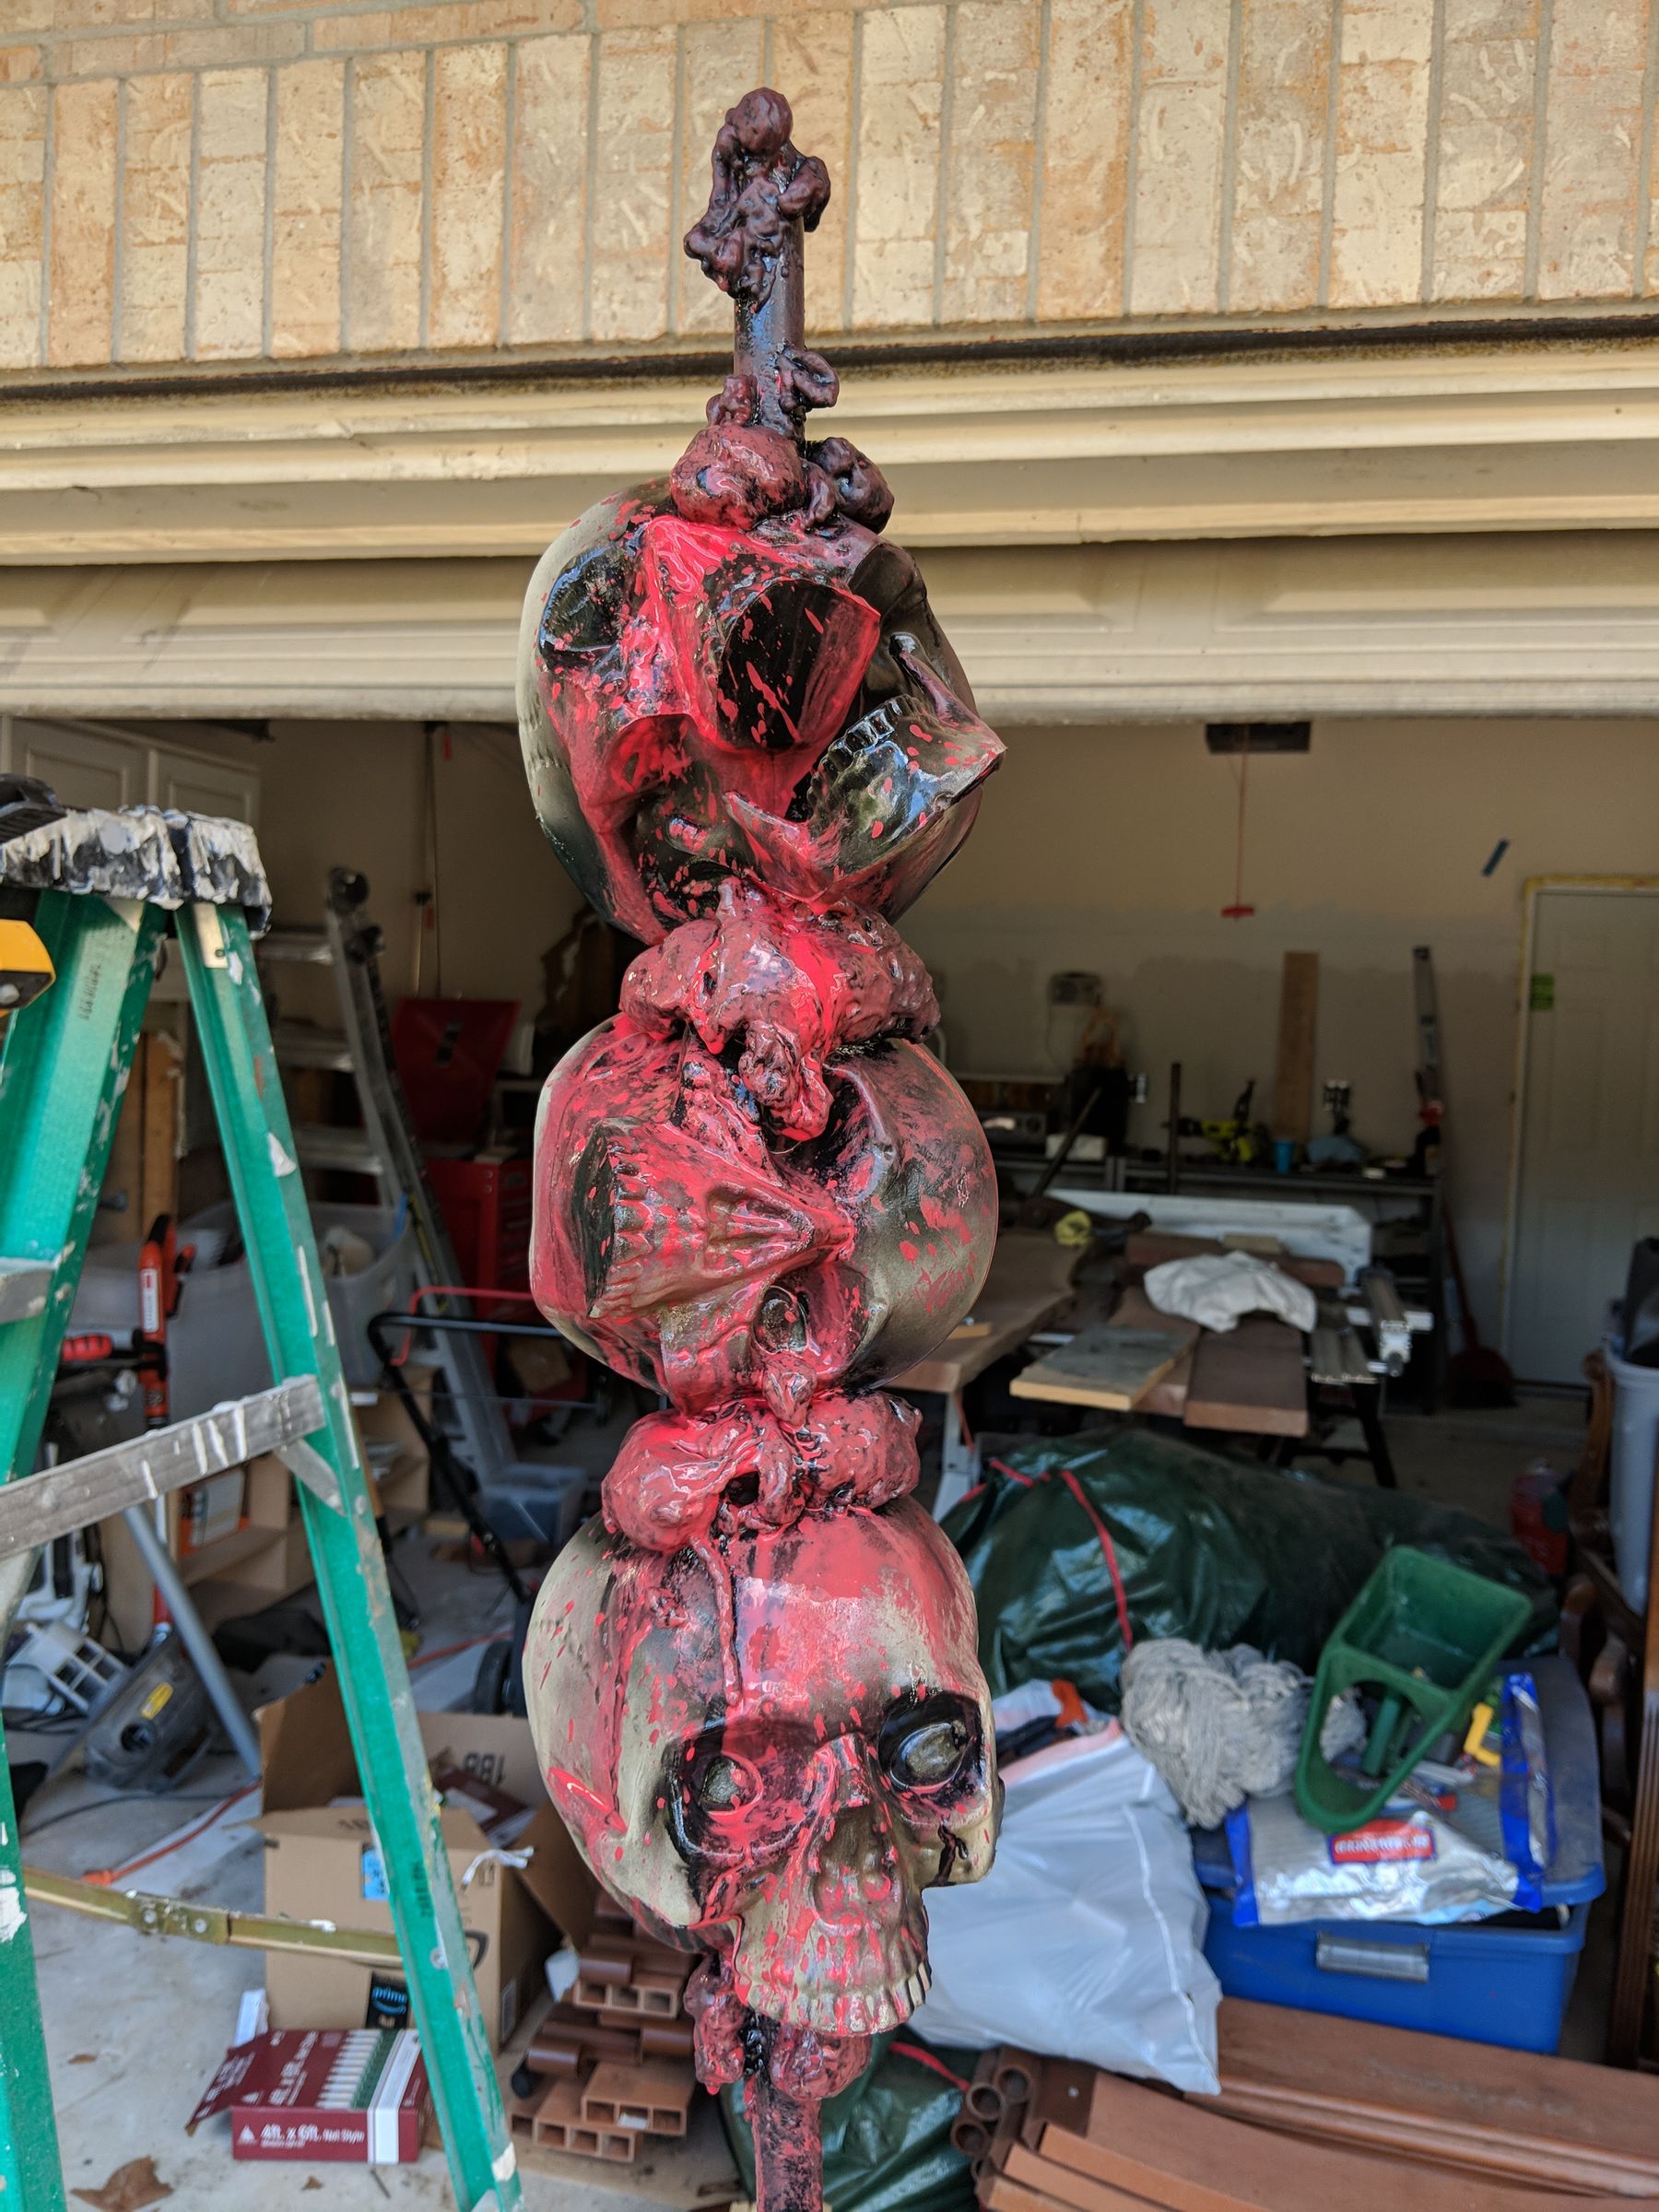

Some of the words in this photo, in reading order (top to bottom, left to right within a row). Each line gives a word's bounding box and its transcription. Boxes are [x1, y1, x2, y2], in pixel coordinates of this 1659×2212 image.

[371, 1986, 407, 2005] prime
[261, 2124, 285, 2140] 4ft.
[286, 2126, 297, 2140] x
